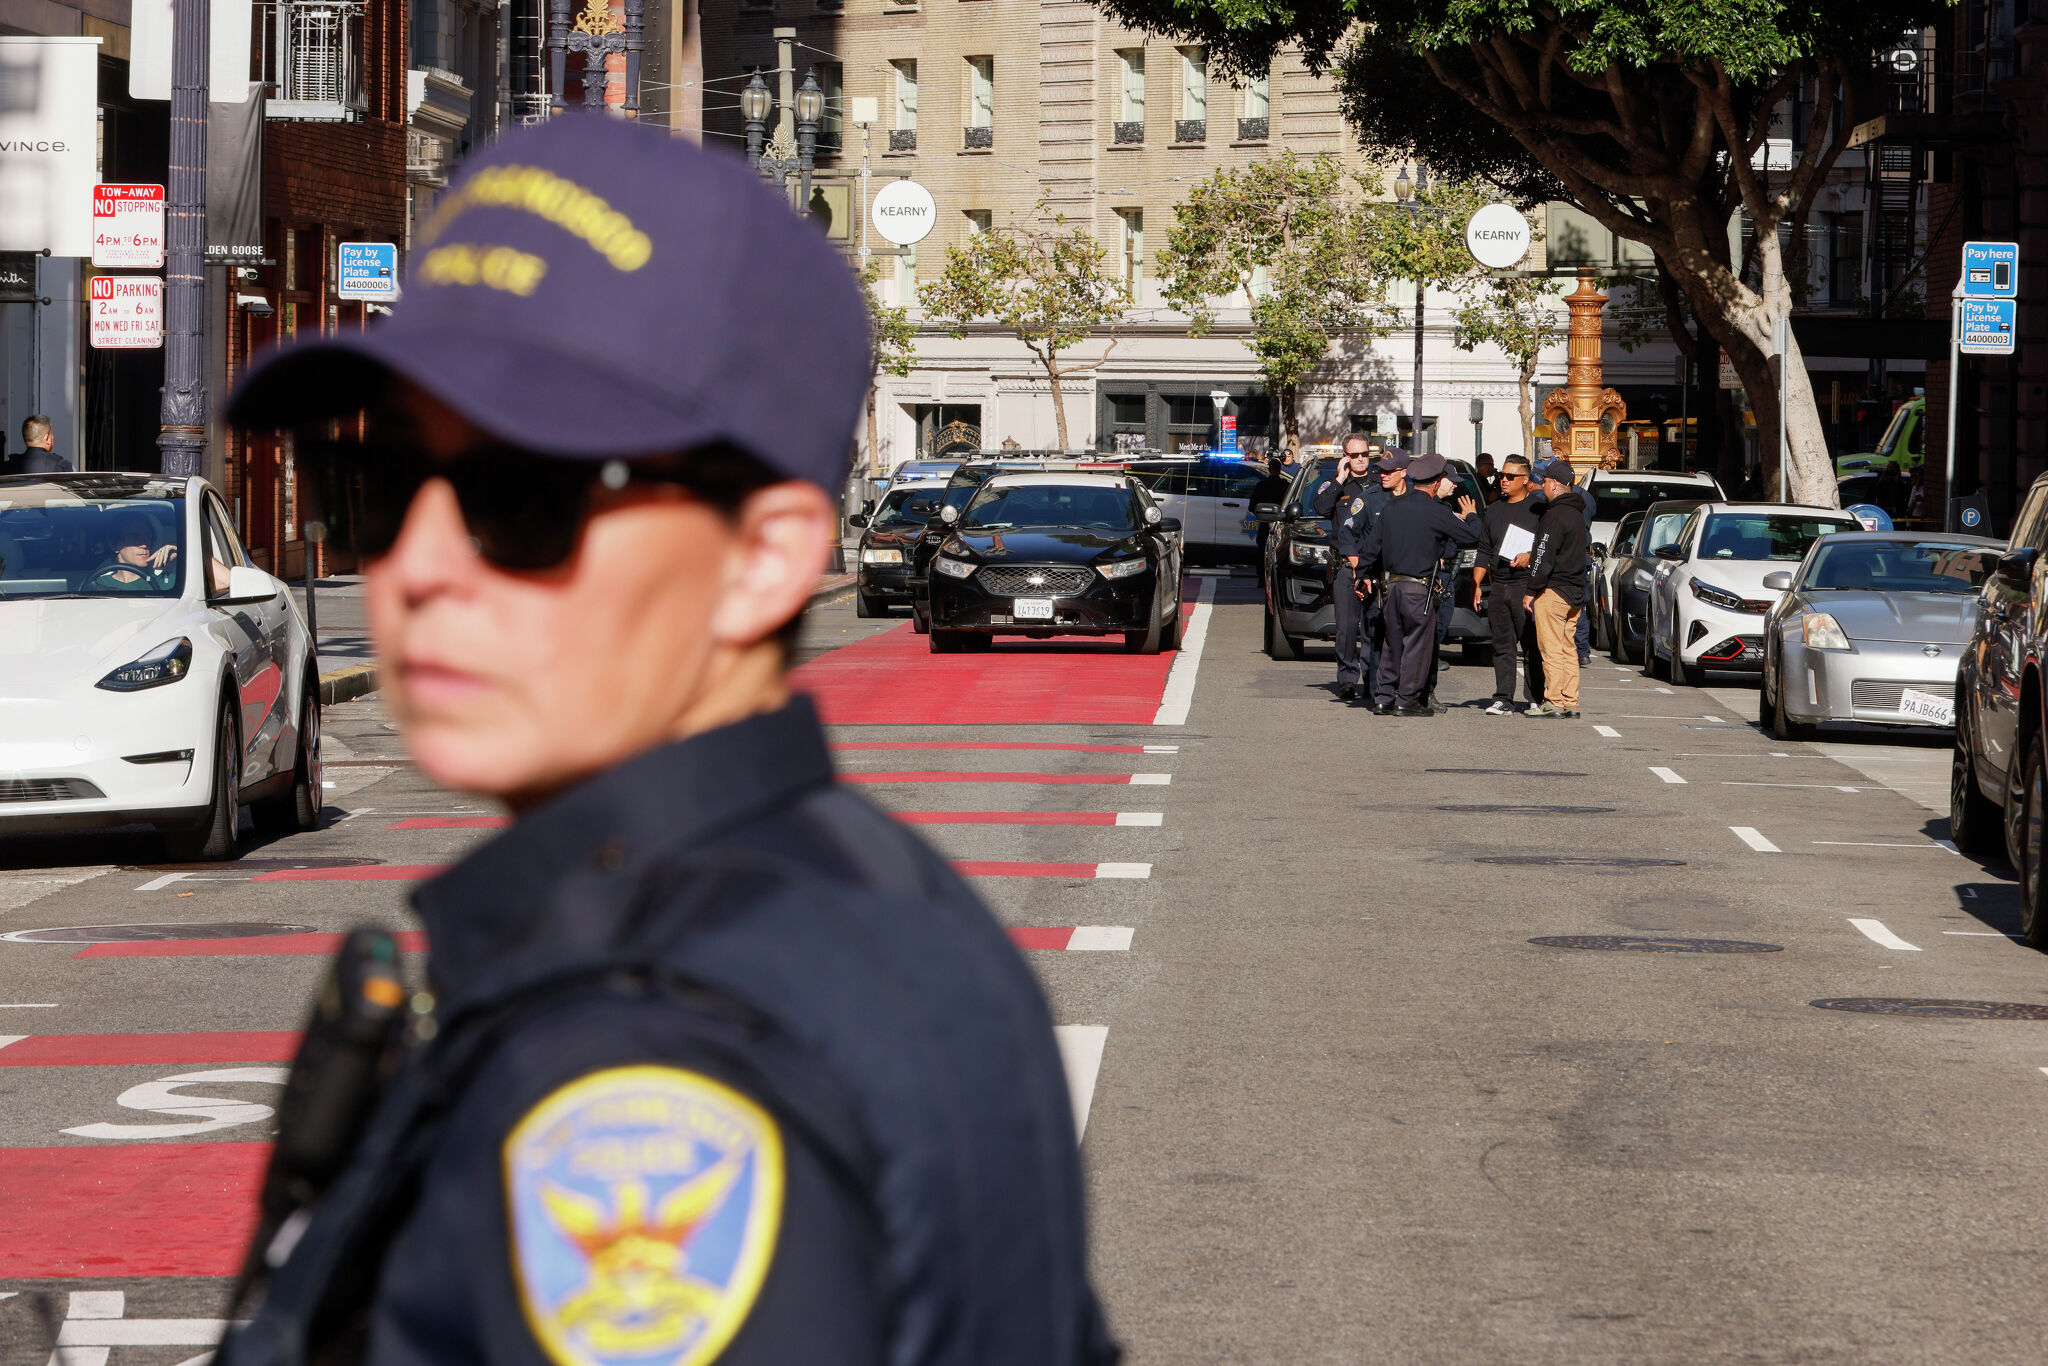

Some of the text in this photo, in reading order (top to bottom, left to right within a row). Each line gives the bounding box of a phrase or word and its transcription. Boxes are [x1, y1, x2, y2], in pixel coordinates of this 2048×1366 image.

[101, 187, 156, 197] TOW-AWAY
[94, 199, 161, 215] NO STOPPING
[880, 206, 928, 217] KEARNY
[1474, 230, 1521, 241] KEARNY
[231, 245, 264, 256] GOOSE
[344, 247, 378, 258] Pay by
[1968, 248, 2014, 261] Pay here
[344, 257, 381, 266] License
[344, 267, 369, 276] Plate
[93, 279, 158, 298] NO PARKING
[345, 280, 389, 289] 44000006
[1966, 302, 1999, 314] Pay by
[1966, 312, 2002, 322] License
[94, 320, 159, 332] MON WED FRI SAT
[1965, 322, 1990, 332] Plate
[97, 337, 157, 345] STREET CLEANING
[1966, 334, 2008, 344] 44000003
[1903, 699, 1948, 720] 9AJB666
